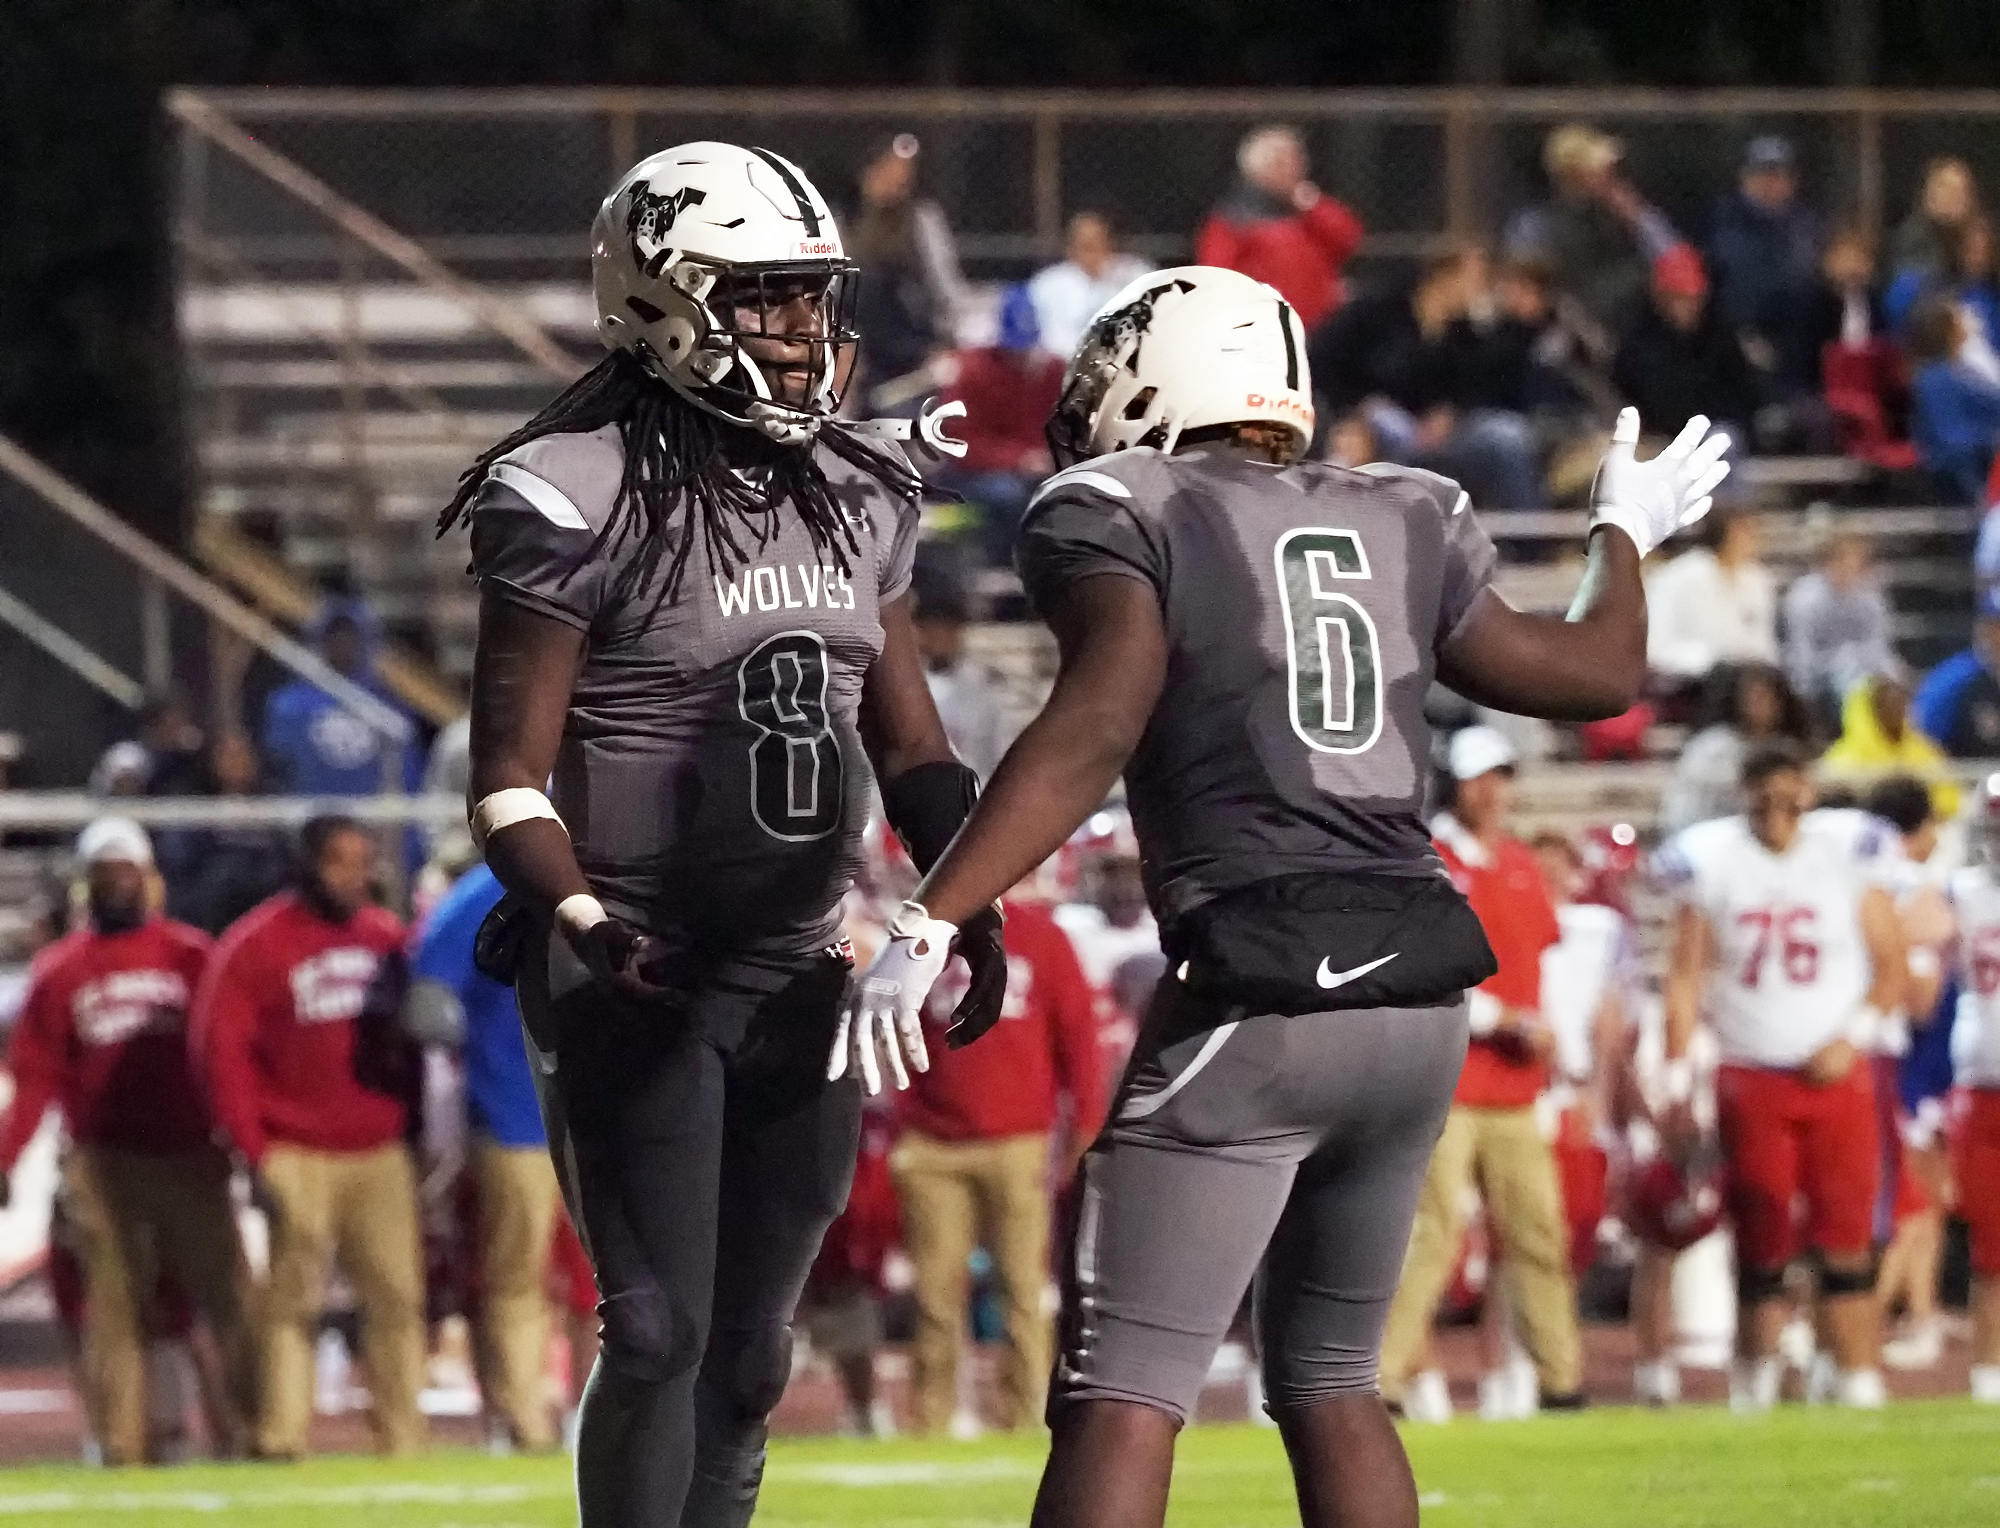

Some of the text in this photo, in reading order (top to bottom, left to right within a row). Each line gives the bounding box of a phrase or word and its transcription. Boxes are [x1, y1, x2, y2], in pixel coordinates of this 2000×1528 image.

[799, 242, 837, 254] Riddell
[714, 564, 855, 617] WOLVES
[1274, 526, 1384, 755] 6
[737, 630, 843, 842] 8
[1736, 908, 1817, 988] 76
